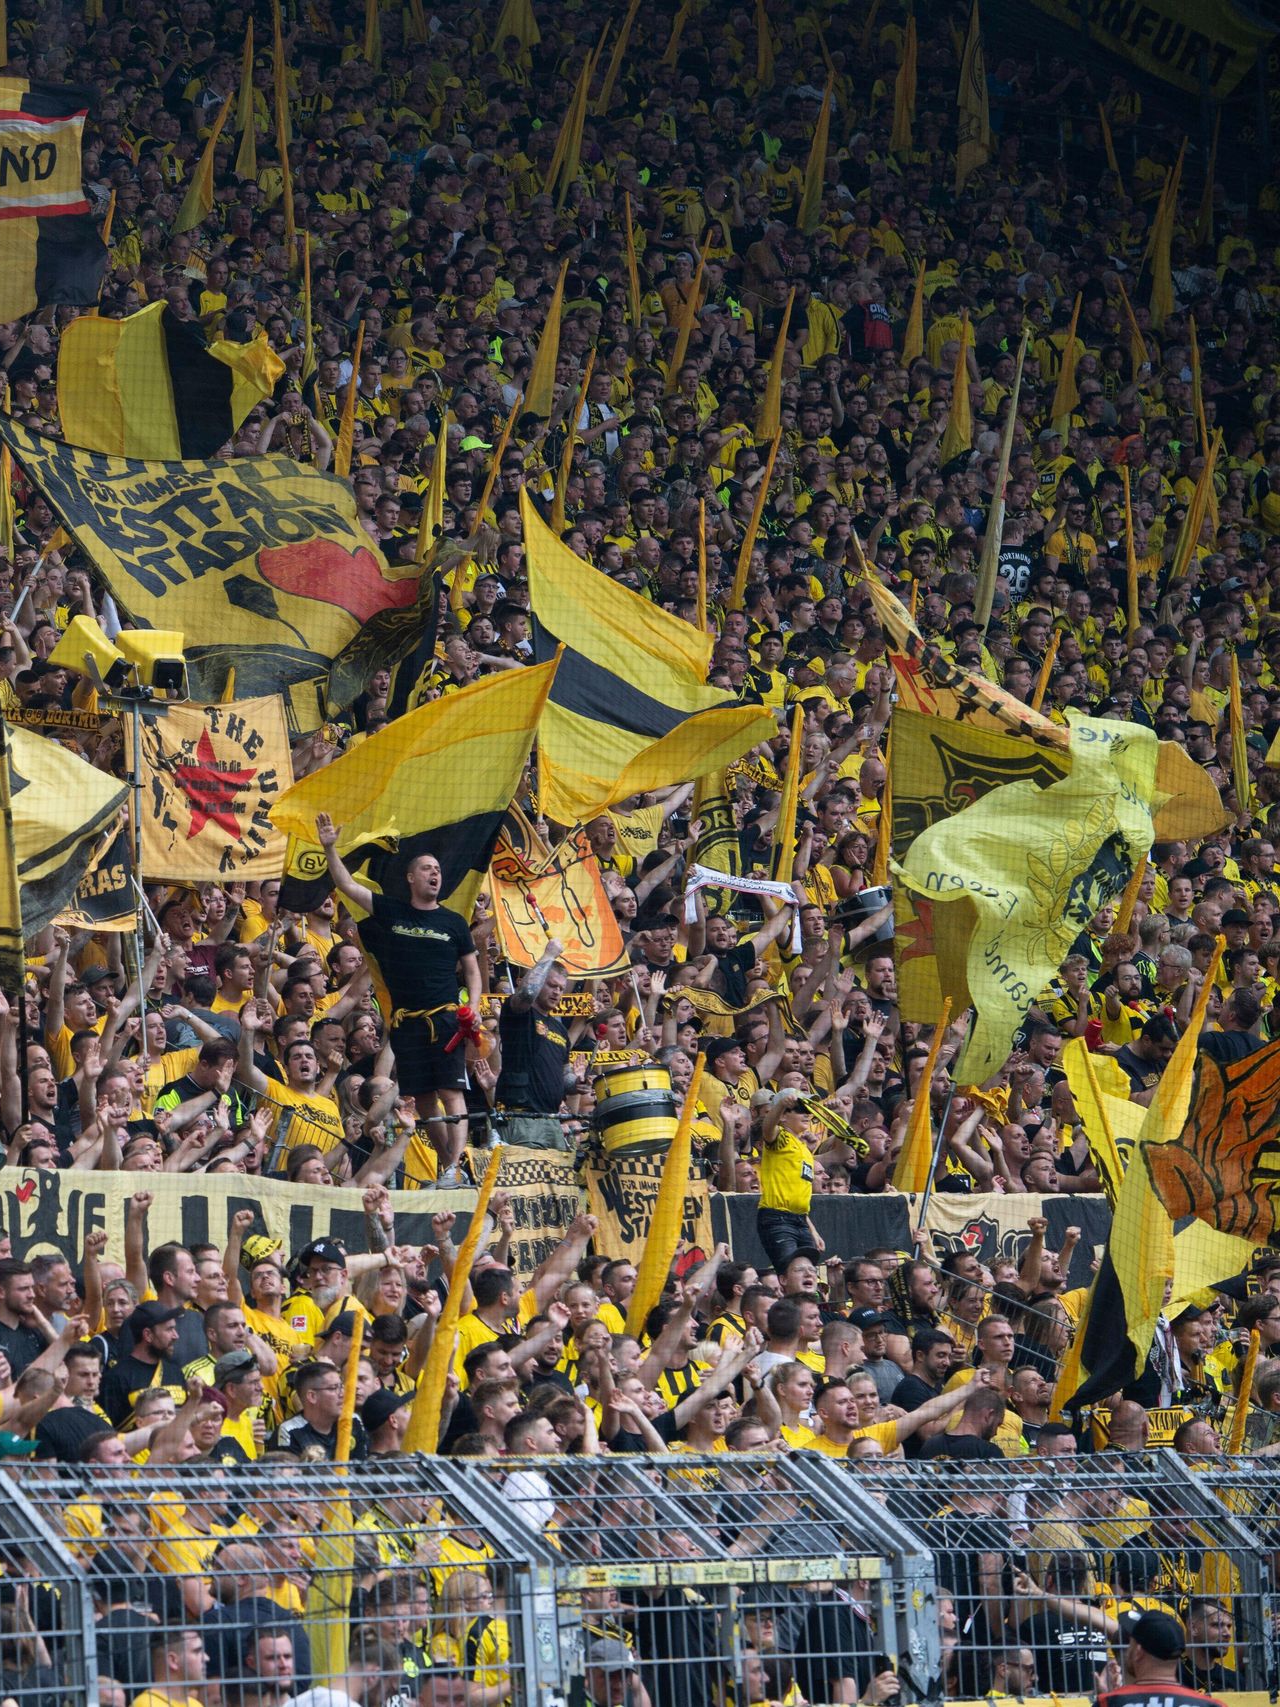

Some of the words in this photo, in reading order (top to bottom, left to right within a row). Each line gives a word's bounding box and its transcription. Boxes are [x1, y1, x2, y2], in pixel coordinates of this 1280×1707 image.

[82, 477, 118, 503] FÜR
[121, 470, 216, 506] IMMER
[114, 507, 356, 598] STADION
[998, 552, 1031, 565] DORTMUND
[1000, 564, 1031, 592] 26
[204, 705, 265, 761] THE
[304, 855, 328, 870] BV
[597, 1168, 704, 1220] WESTEN
[621, 1179, 638, 1191] FÜR
[640, 1181, 661, 1193] IMME
